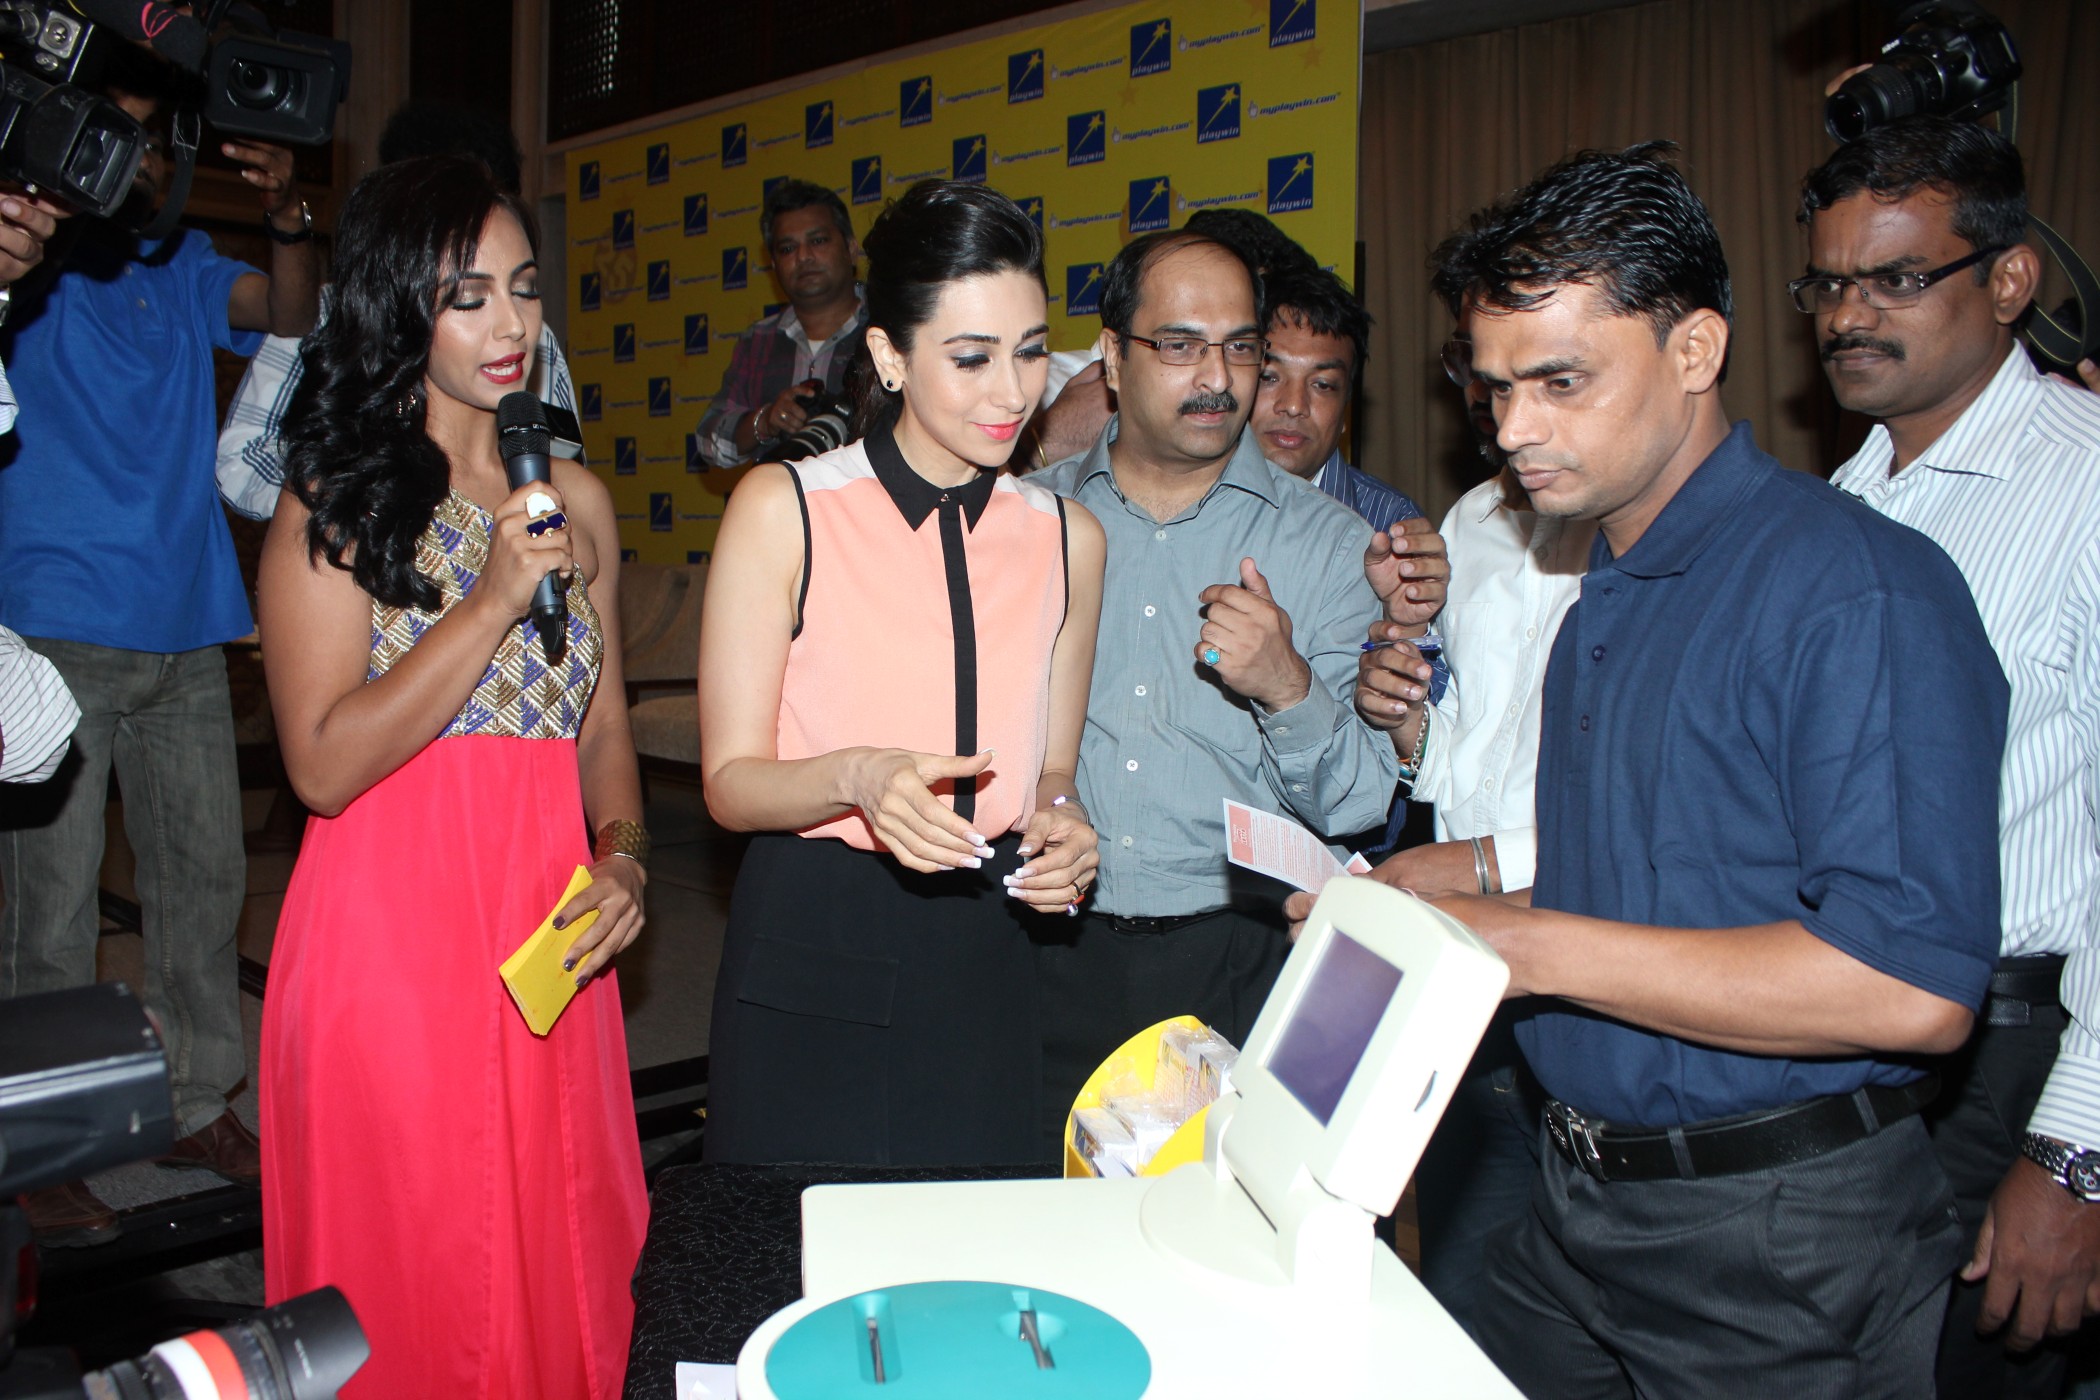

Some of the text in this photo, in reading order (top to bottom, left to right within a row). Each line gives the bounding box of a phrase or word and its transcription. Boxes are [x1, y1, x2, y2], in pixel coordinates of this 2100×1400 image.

[1189, 24, 1262, 49] myplaywin.com
[1270, 27, 1315, 47] playwin
[1131, 60, 1170, 77] playwin
[1259, 93, 1337, 116] myplaywin.com
[1198, 126, 1240, 143] playwin
[1068, 151, 1105, 166] playwin
[1187, 190, 1260, 209] myplaywin.com
[1268, 197, 1313, 213] playwin
[1130, 217, 1169, 232] playwin
[1068, 303, 1100, 316] playwi
